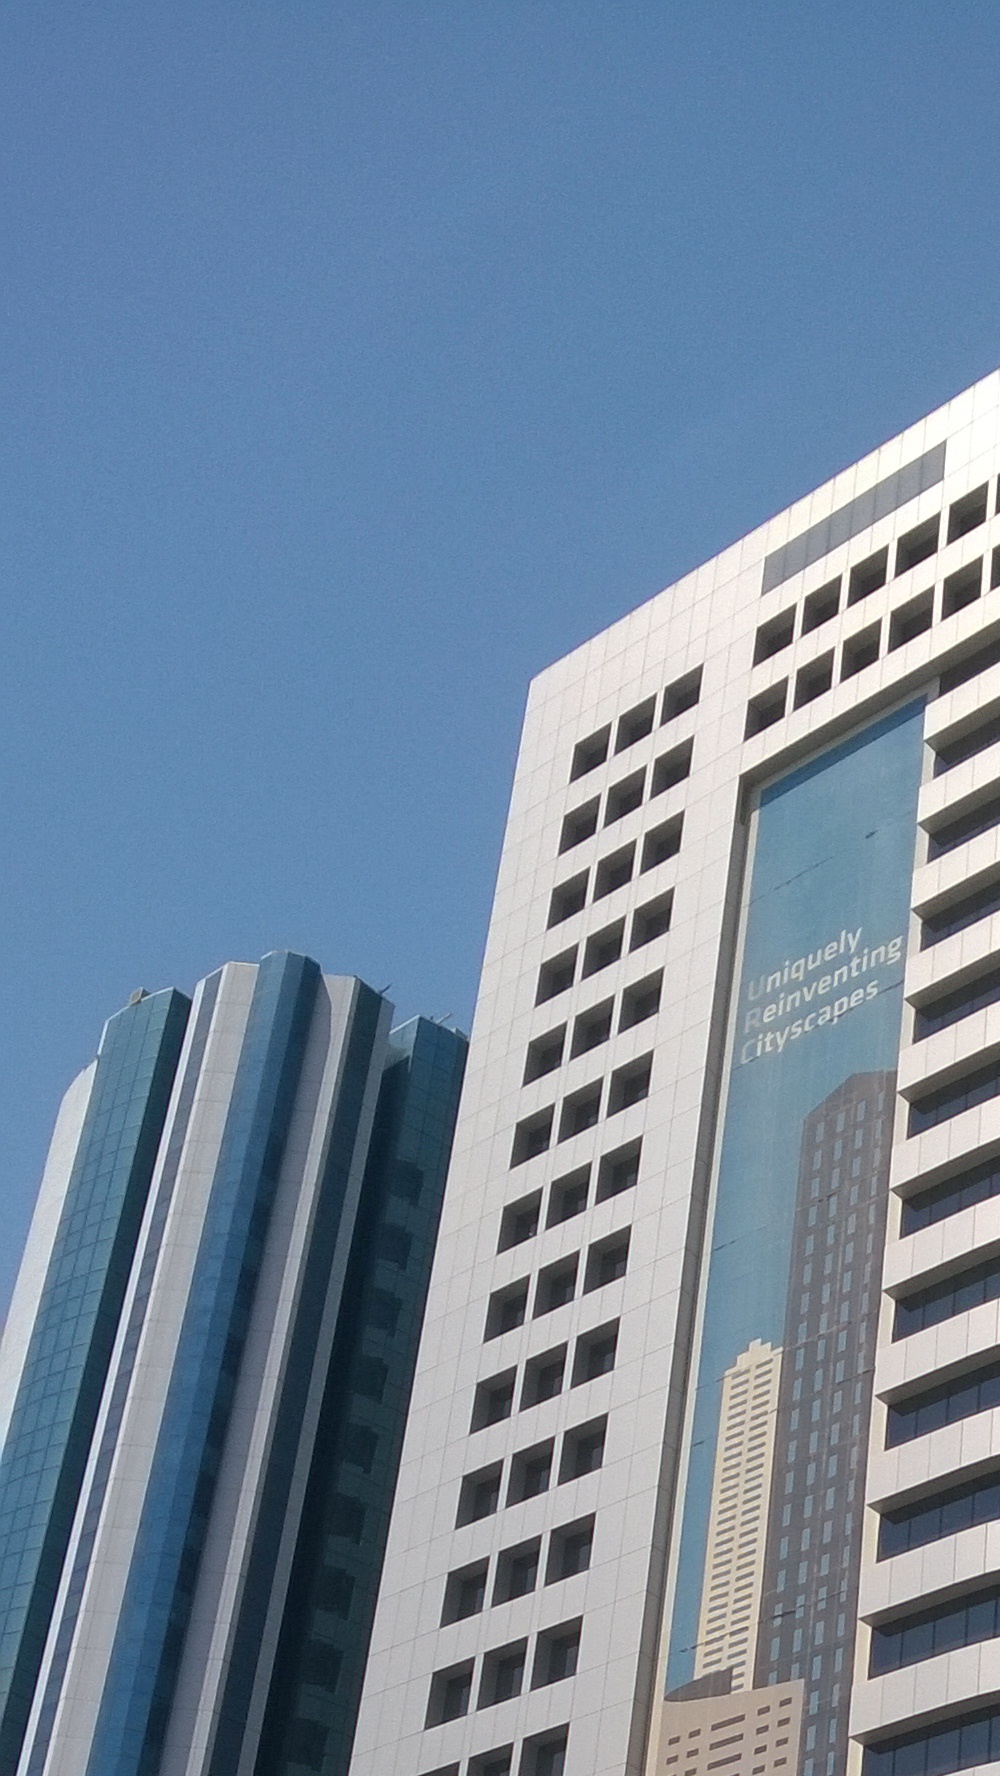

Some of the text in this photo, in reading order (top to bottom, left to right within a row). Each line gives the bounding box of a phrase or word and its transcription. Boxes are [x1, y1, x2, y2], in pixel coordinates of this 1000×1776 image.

[744, 935, 903, 1034] Reinventing
[748, 926, 862, 1000] Uniquely
[740, 979, 878, 1065] Cityscapes
